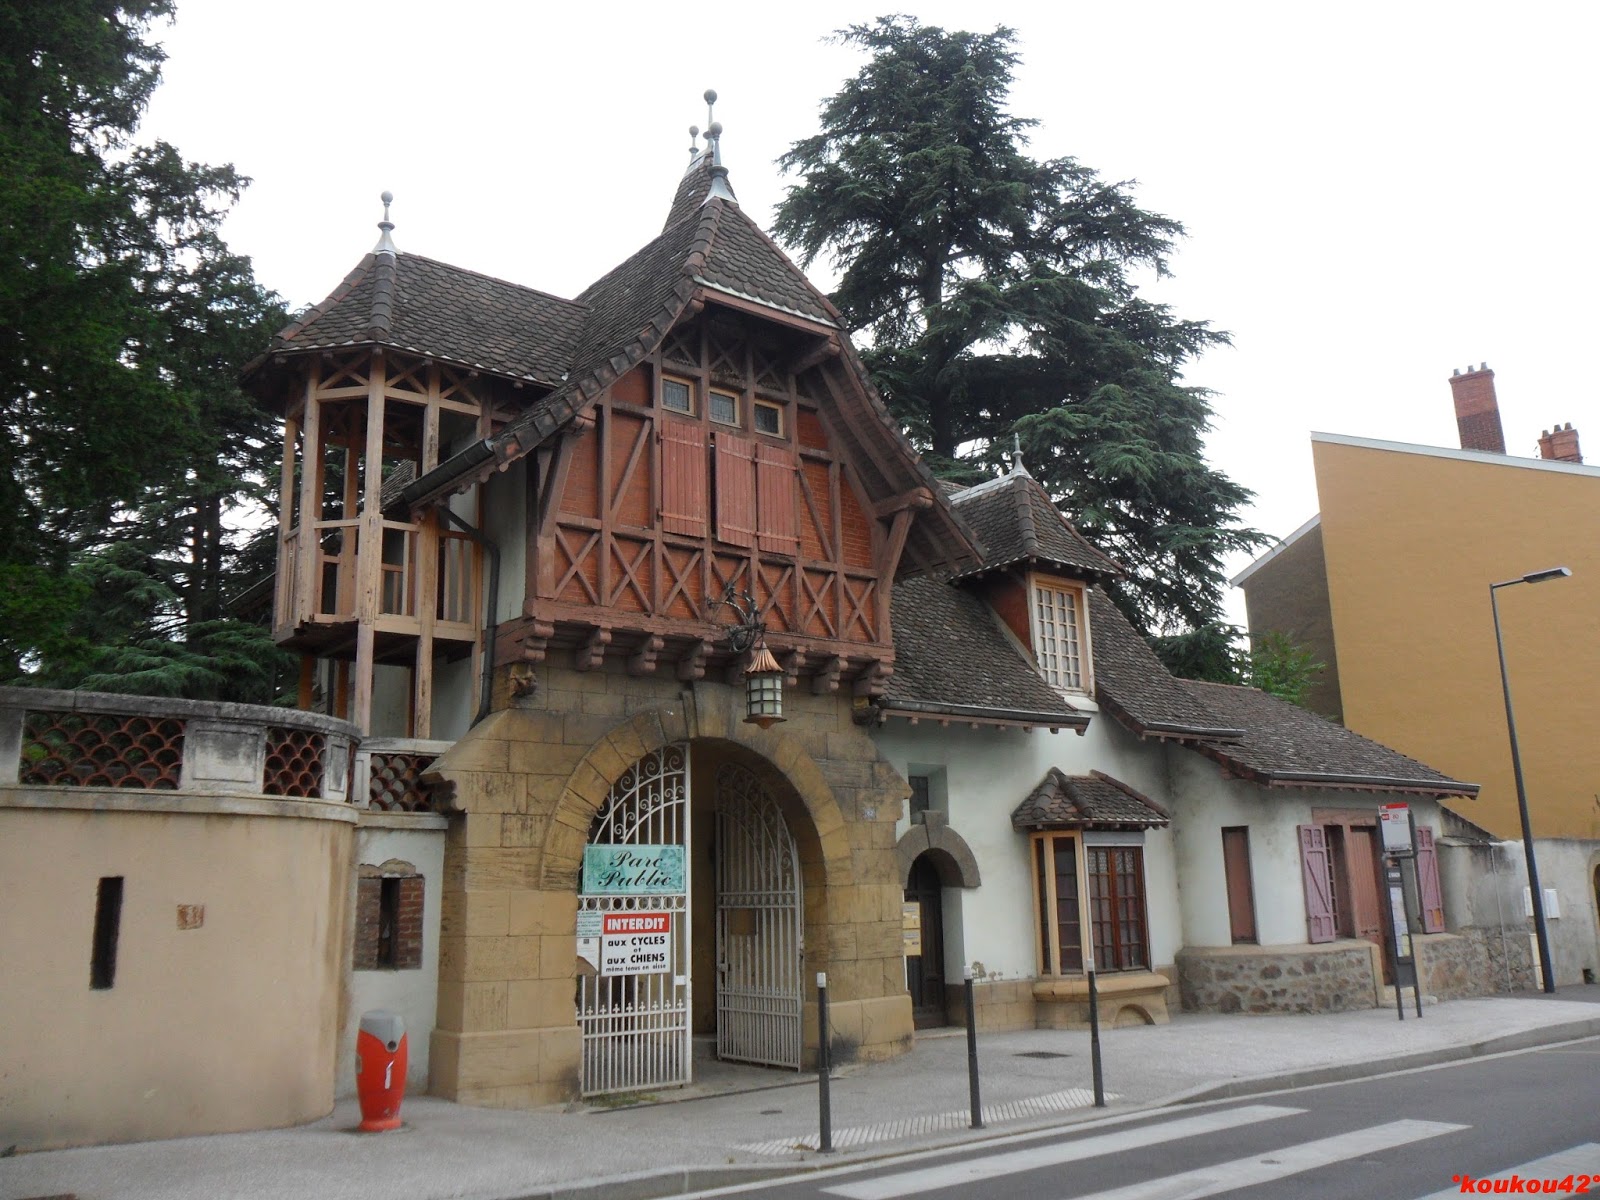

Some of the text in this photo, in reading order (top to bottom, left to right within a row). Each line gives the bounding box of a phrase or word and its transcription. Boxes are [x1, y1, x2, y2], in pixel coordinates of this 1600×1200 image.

[609, 851, 663, 868] Parc
[598, 869, 671, 887] Public
[607, 918, 665, 931] INTERDIT
[608, 936, 665, 947] aux CYCLES
[607, 952, 665, 965] aux CHIENS
